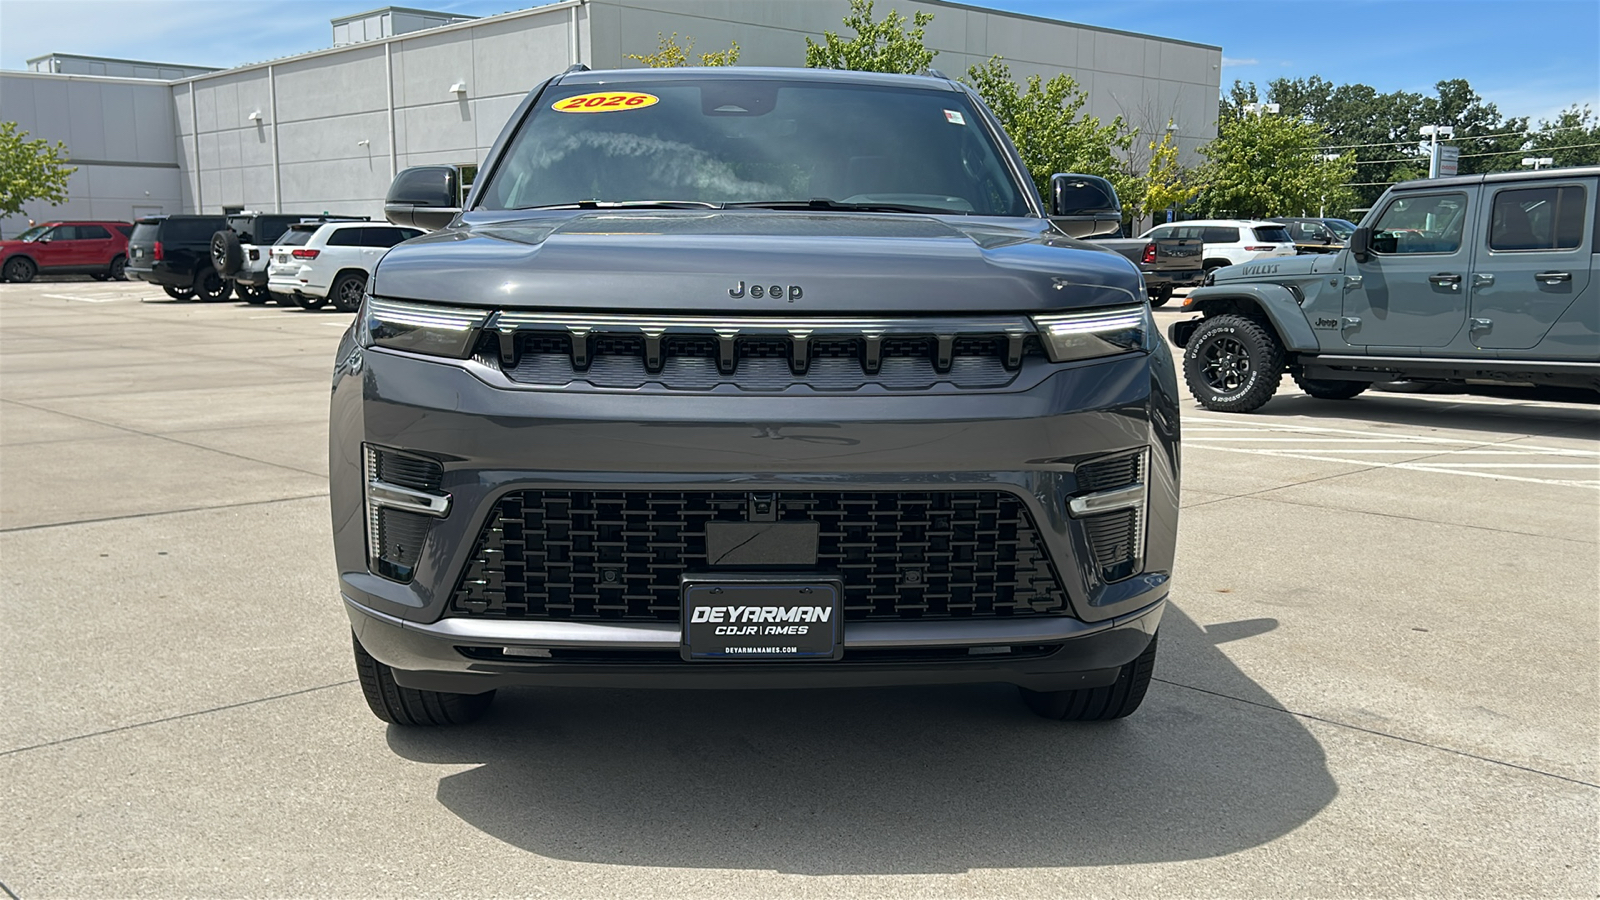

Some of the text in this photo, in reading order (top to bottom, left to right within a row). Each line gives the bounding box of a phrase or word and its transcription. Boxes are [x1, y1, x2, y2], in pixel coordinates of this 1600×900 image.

[561, 96, 648, 109] 2026
[1242, 264, 1280, 275] WILLYS
[727, 280, 803, 303] Jeep
[1314, 317, 1338, 328] Jeep
[690, 606, 832, 623] DEYARMAN
[714, 626, 809, 635] CDJR AMES
